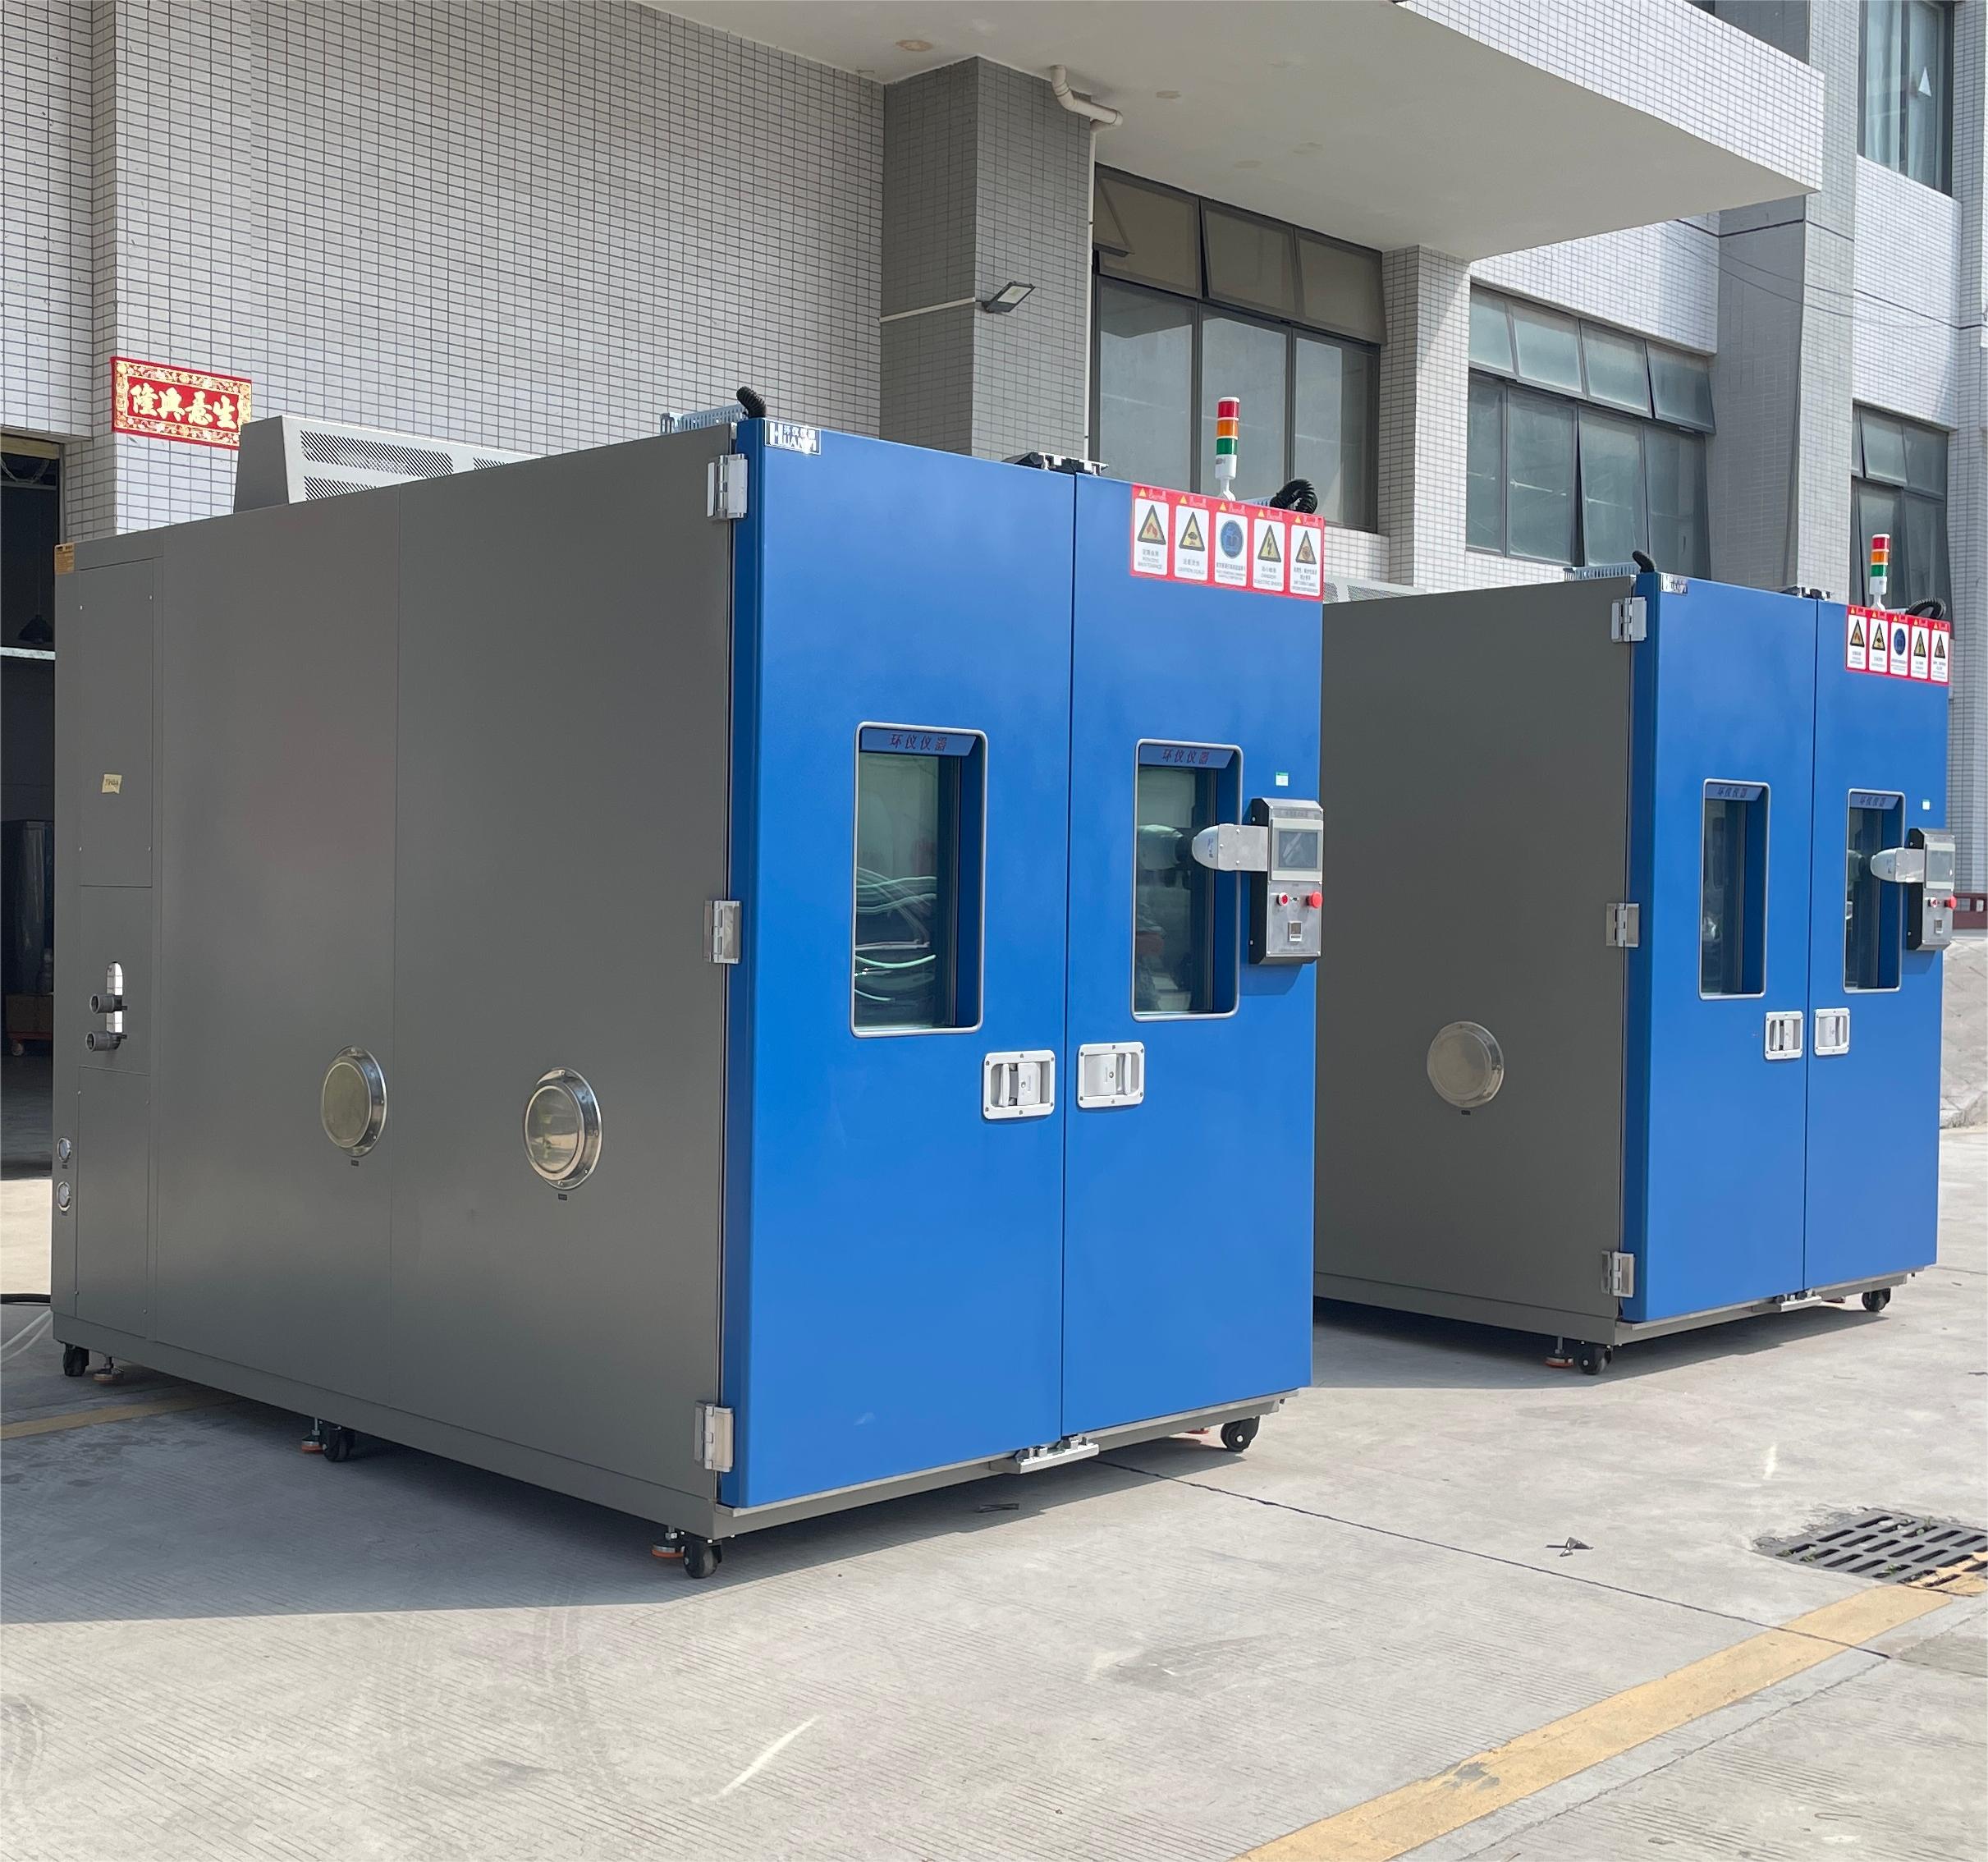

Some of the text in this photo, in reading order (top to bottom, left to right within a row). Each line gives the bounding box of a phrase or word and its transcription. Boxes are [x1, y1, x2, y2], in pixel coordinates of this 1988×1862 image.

[889, 733, 947, 752] 环仪仪器
[1161, 748, 1210, 764] 环仪仪器
